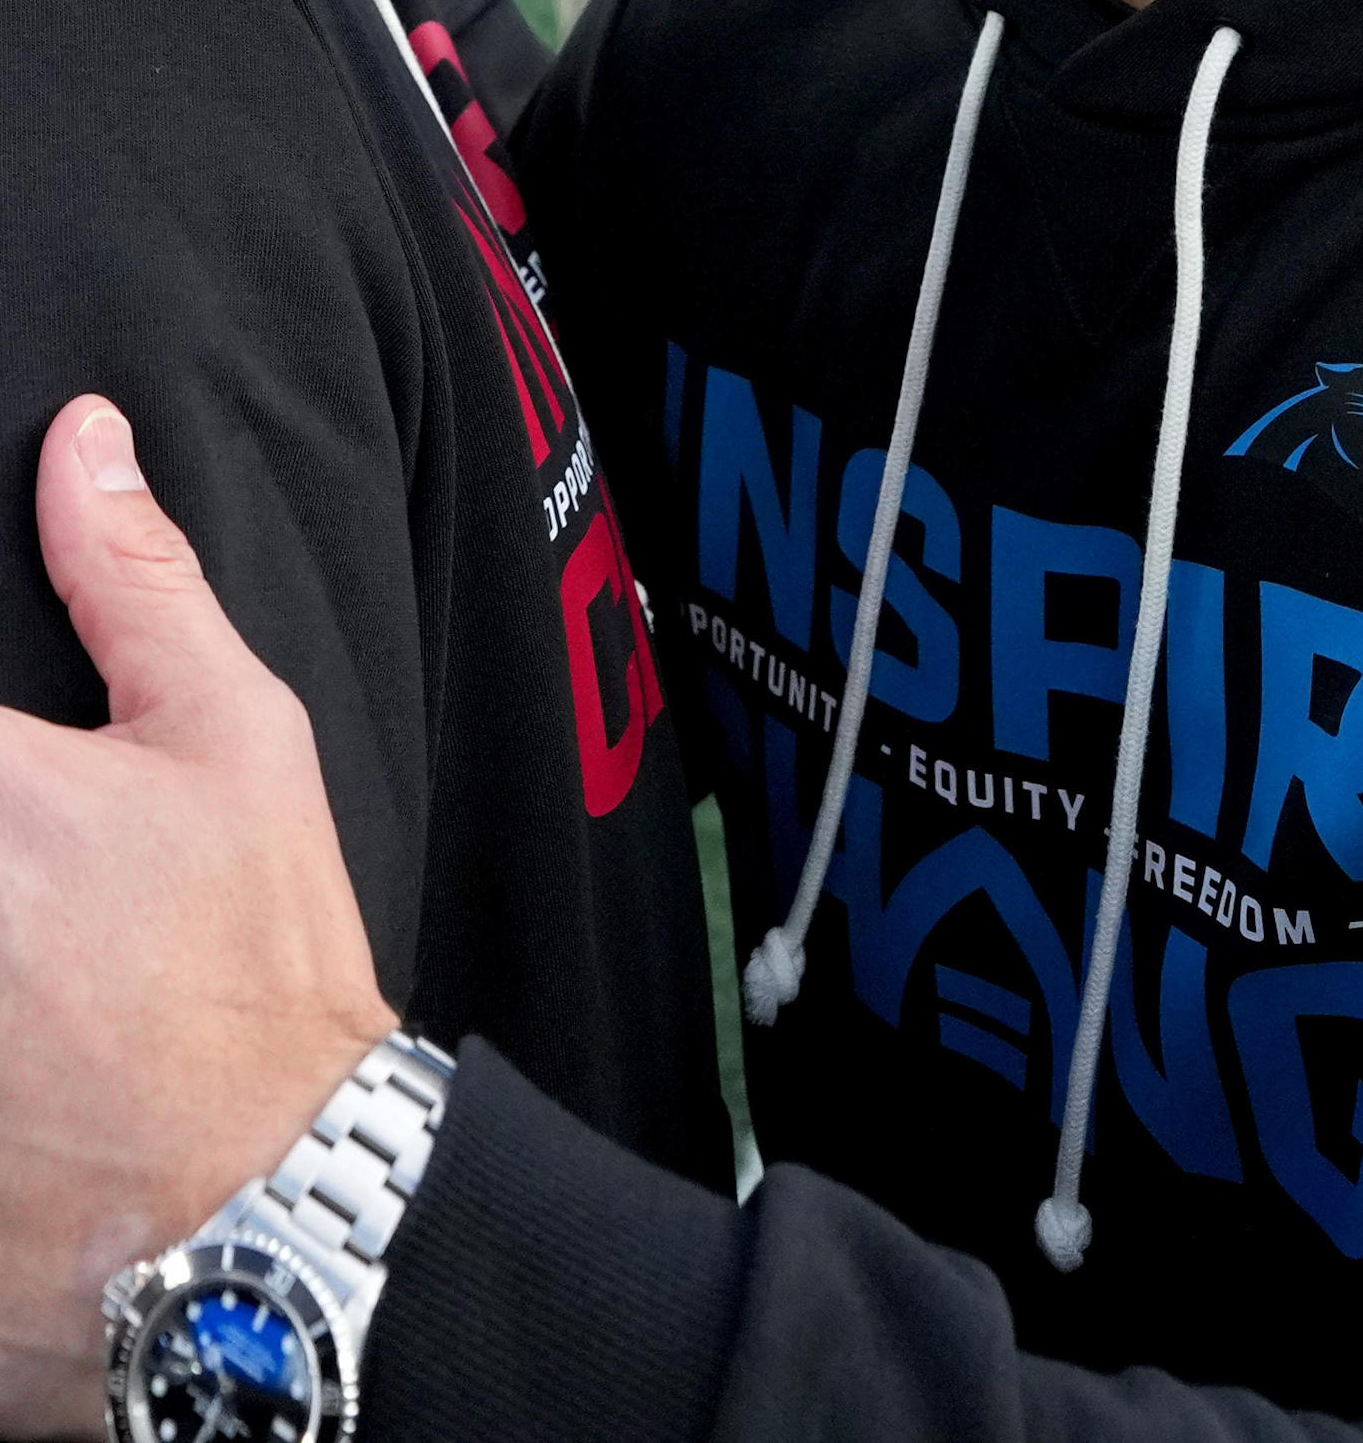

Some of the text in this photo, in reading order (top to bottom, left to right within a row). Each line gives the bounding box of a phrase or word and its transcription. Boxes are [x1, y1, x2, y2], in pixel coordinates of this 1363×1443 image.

[680, 601, 838, 732] PORTUNIT
[909, 744, 1085, 831] EQUITY
[1132, 832, 1316, 945] REEDOM
